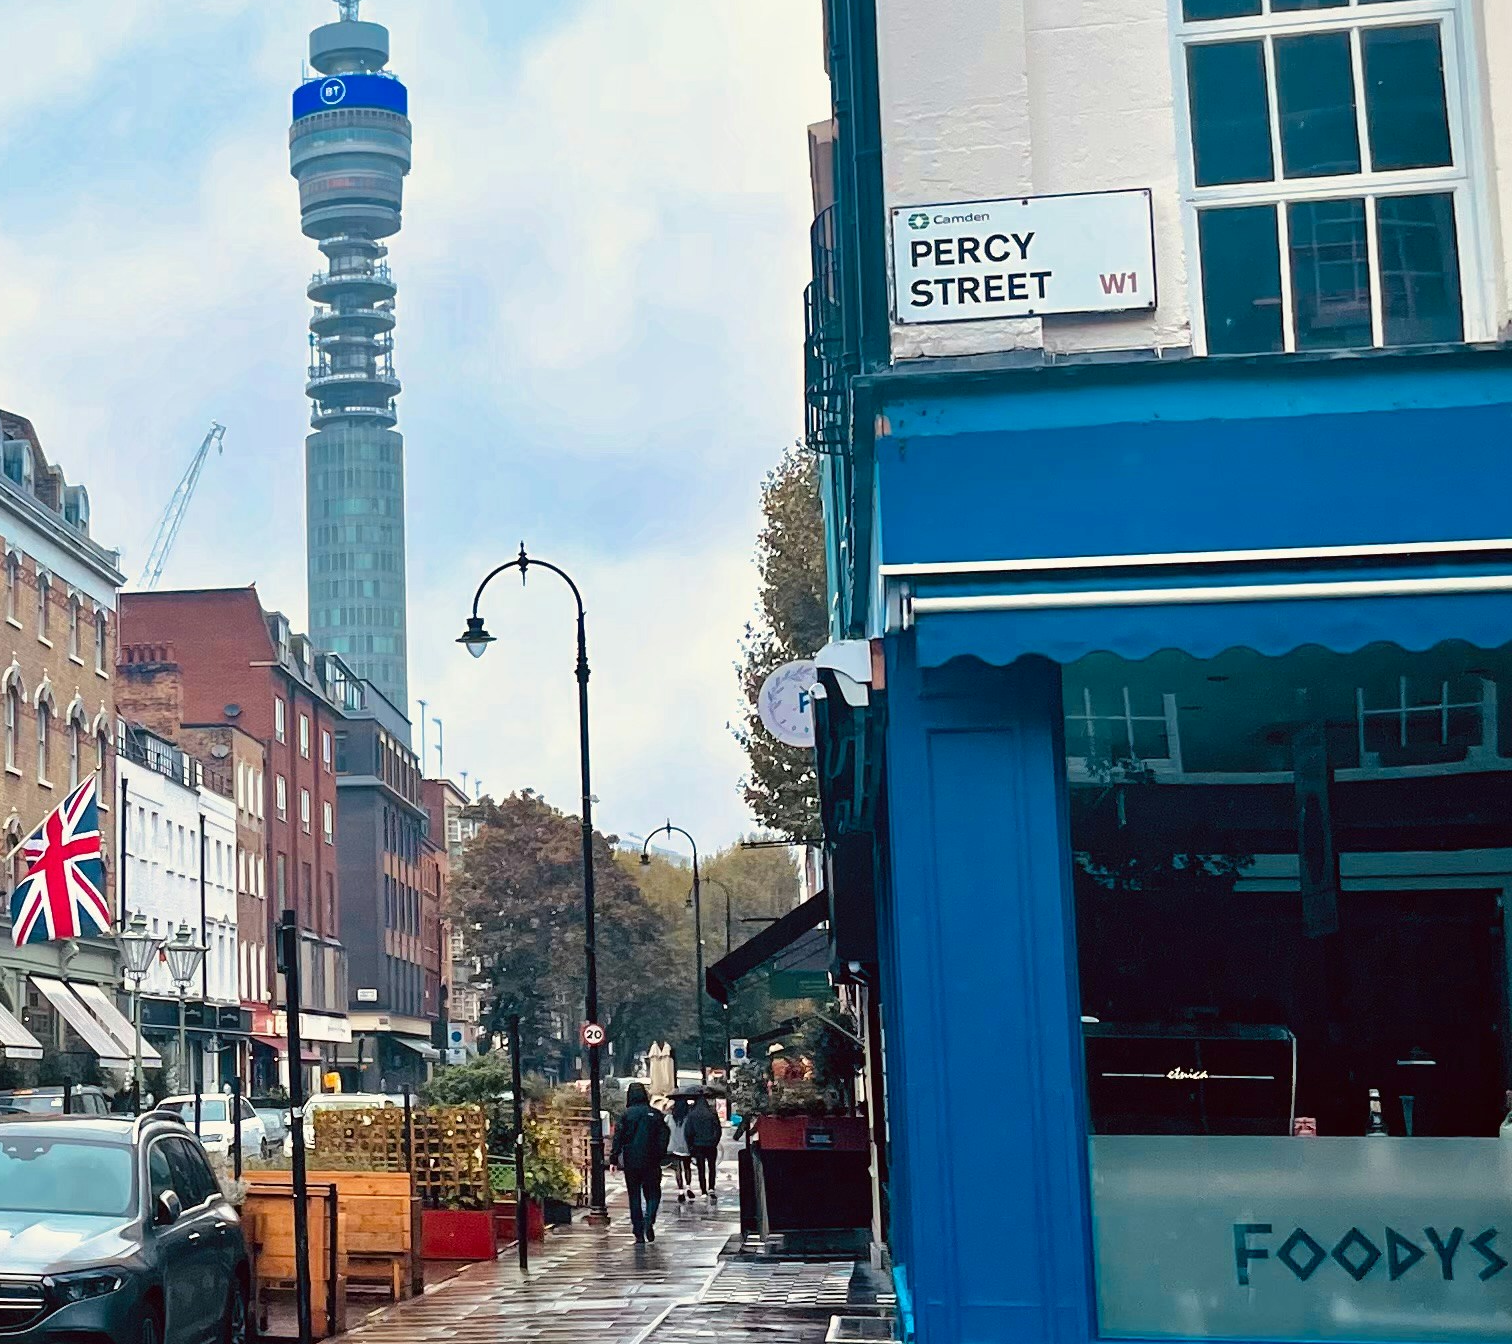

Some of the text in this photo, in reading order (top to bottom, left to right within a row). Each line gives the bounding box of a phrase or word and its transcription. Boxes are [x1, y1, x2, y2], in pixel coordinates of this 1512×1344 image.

[325, 86, 340, 96] BT
[933, 213, 990, 224] Camden
[911, 233, 1035, 268] PERCY
[910, 271, 1052, 307] STREET
[1099, 272, 1138, 294] W1
[585, 1029, 603, 1040] 20
[1233, 1223, 1509, 1286] FOODYS
